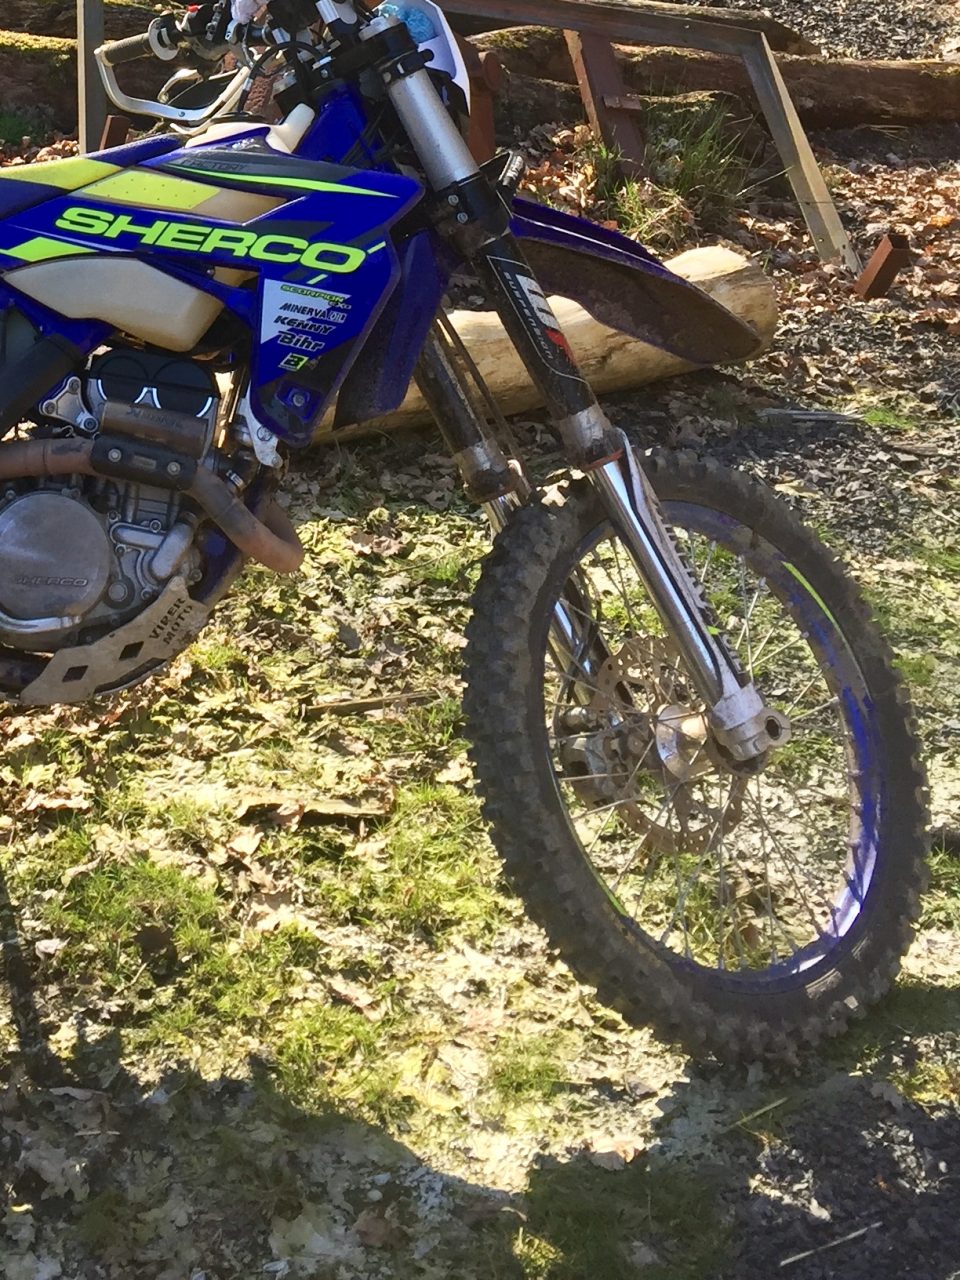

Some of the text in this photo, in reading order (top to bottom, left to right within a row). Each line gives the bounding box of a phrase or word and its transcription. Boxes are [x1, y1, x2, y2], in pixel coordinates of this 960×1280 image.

[55, 206, 367, 273] SHERCO
[279, 302, 328, 320] MINERVA
[273, 315, 337, 335] KENNY
[277, 330, 325, 352] Bihr
